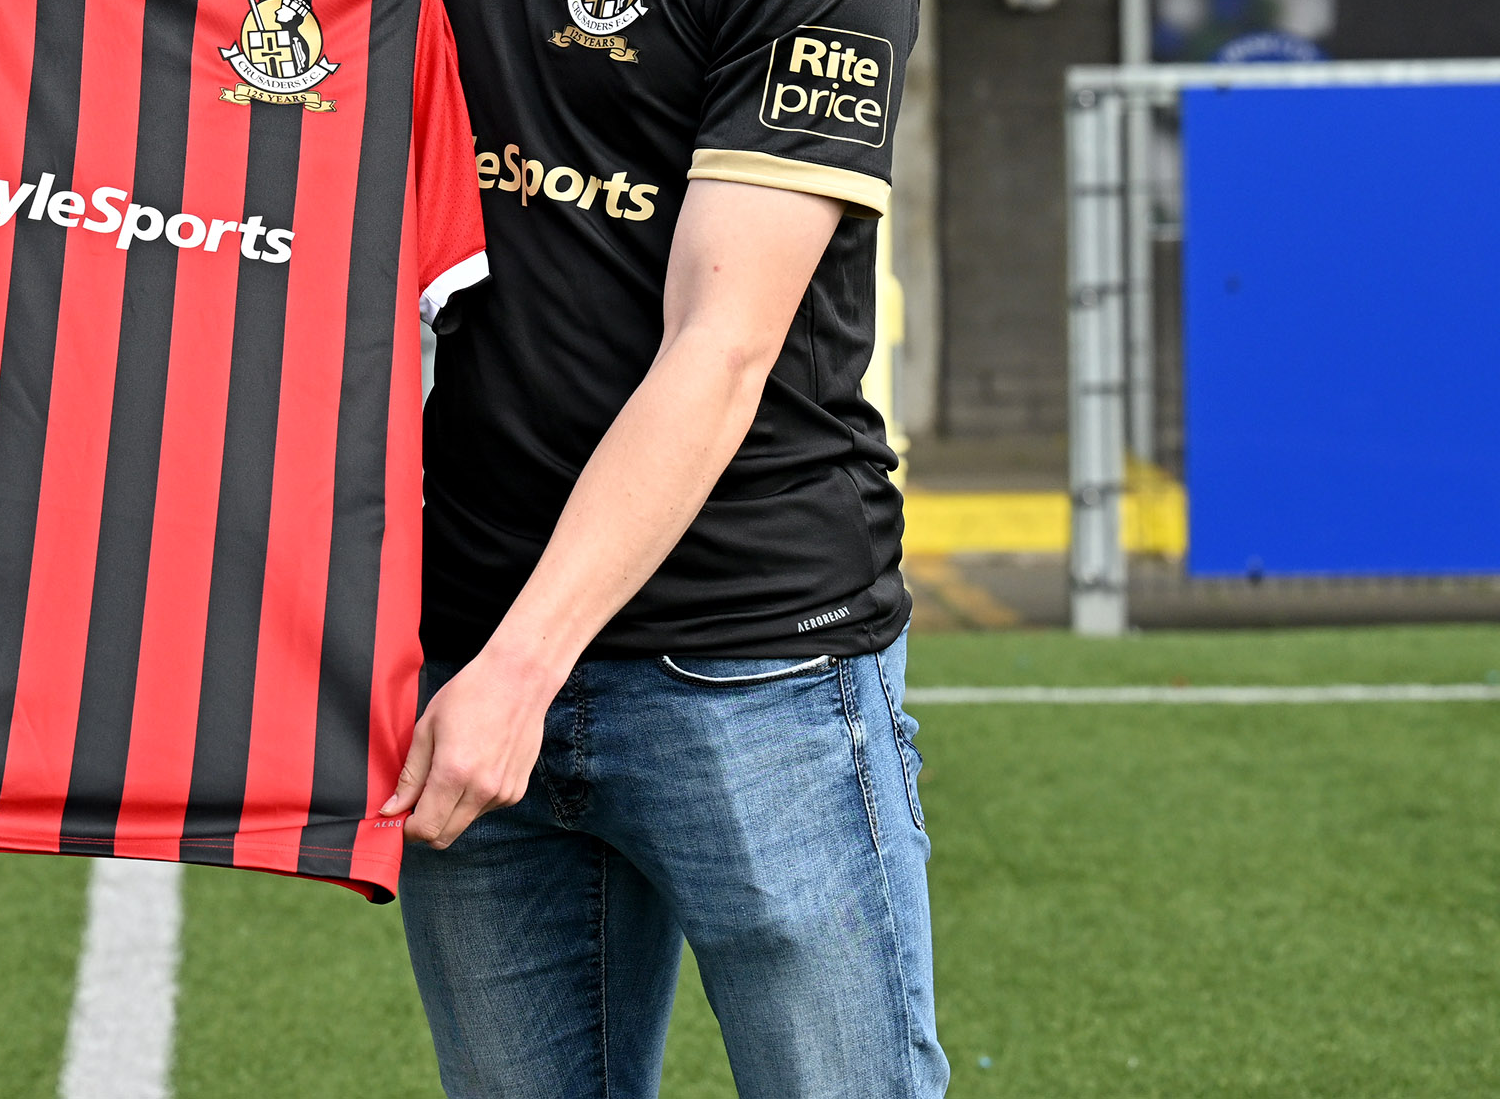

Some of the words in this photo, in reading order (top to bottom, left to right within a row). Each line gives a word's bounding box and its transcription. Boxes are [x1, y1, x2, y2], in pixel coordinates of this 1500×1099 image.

[571, 0, 614, 31] CRUSADERS
[570, 29, 582, 41] 125
[583, 35, 615, 47] YEARS
[238, 60, 302, 89] CRUSADERS
[788, 36, 880, 87] Rite
[246, 88, 264, 100] 125
[267, 94, 308, 103] YEARS
[770, 82, 882, 128] price
[473, 137, 660, 222] eSports
[797, 605, 851, 633] AEROREADY
[374, 819, 402, 828] AERO
